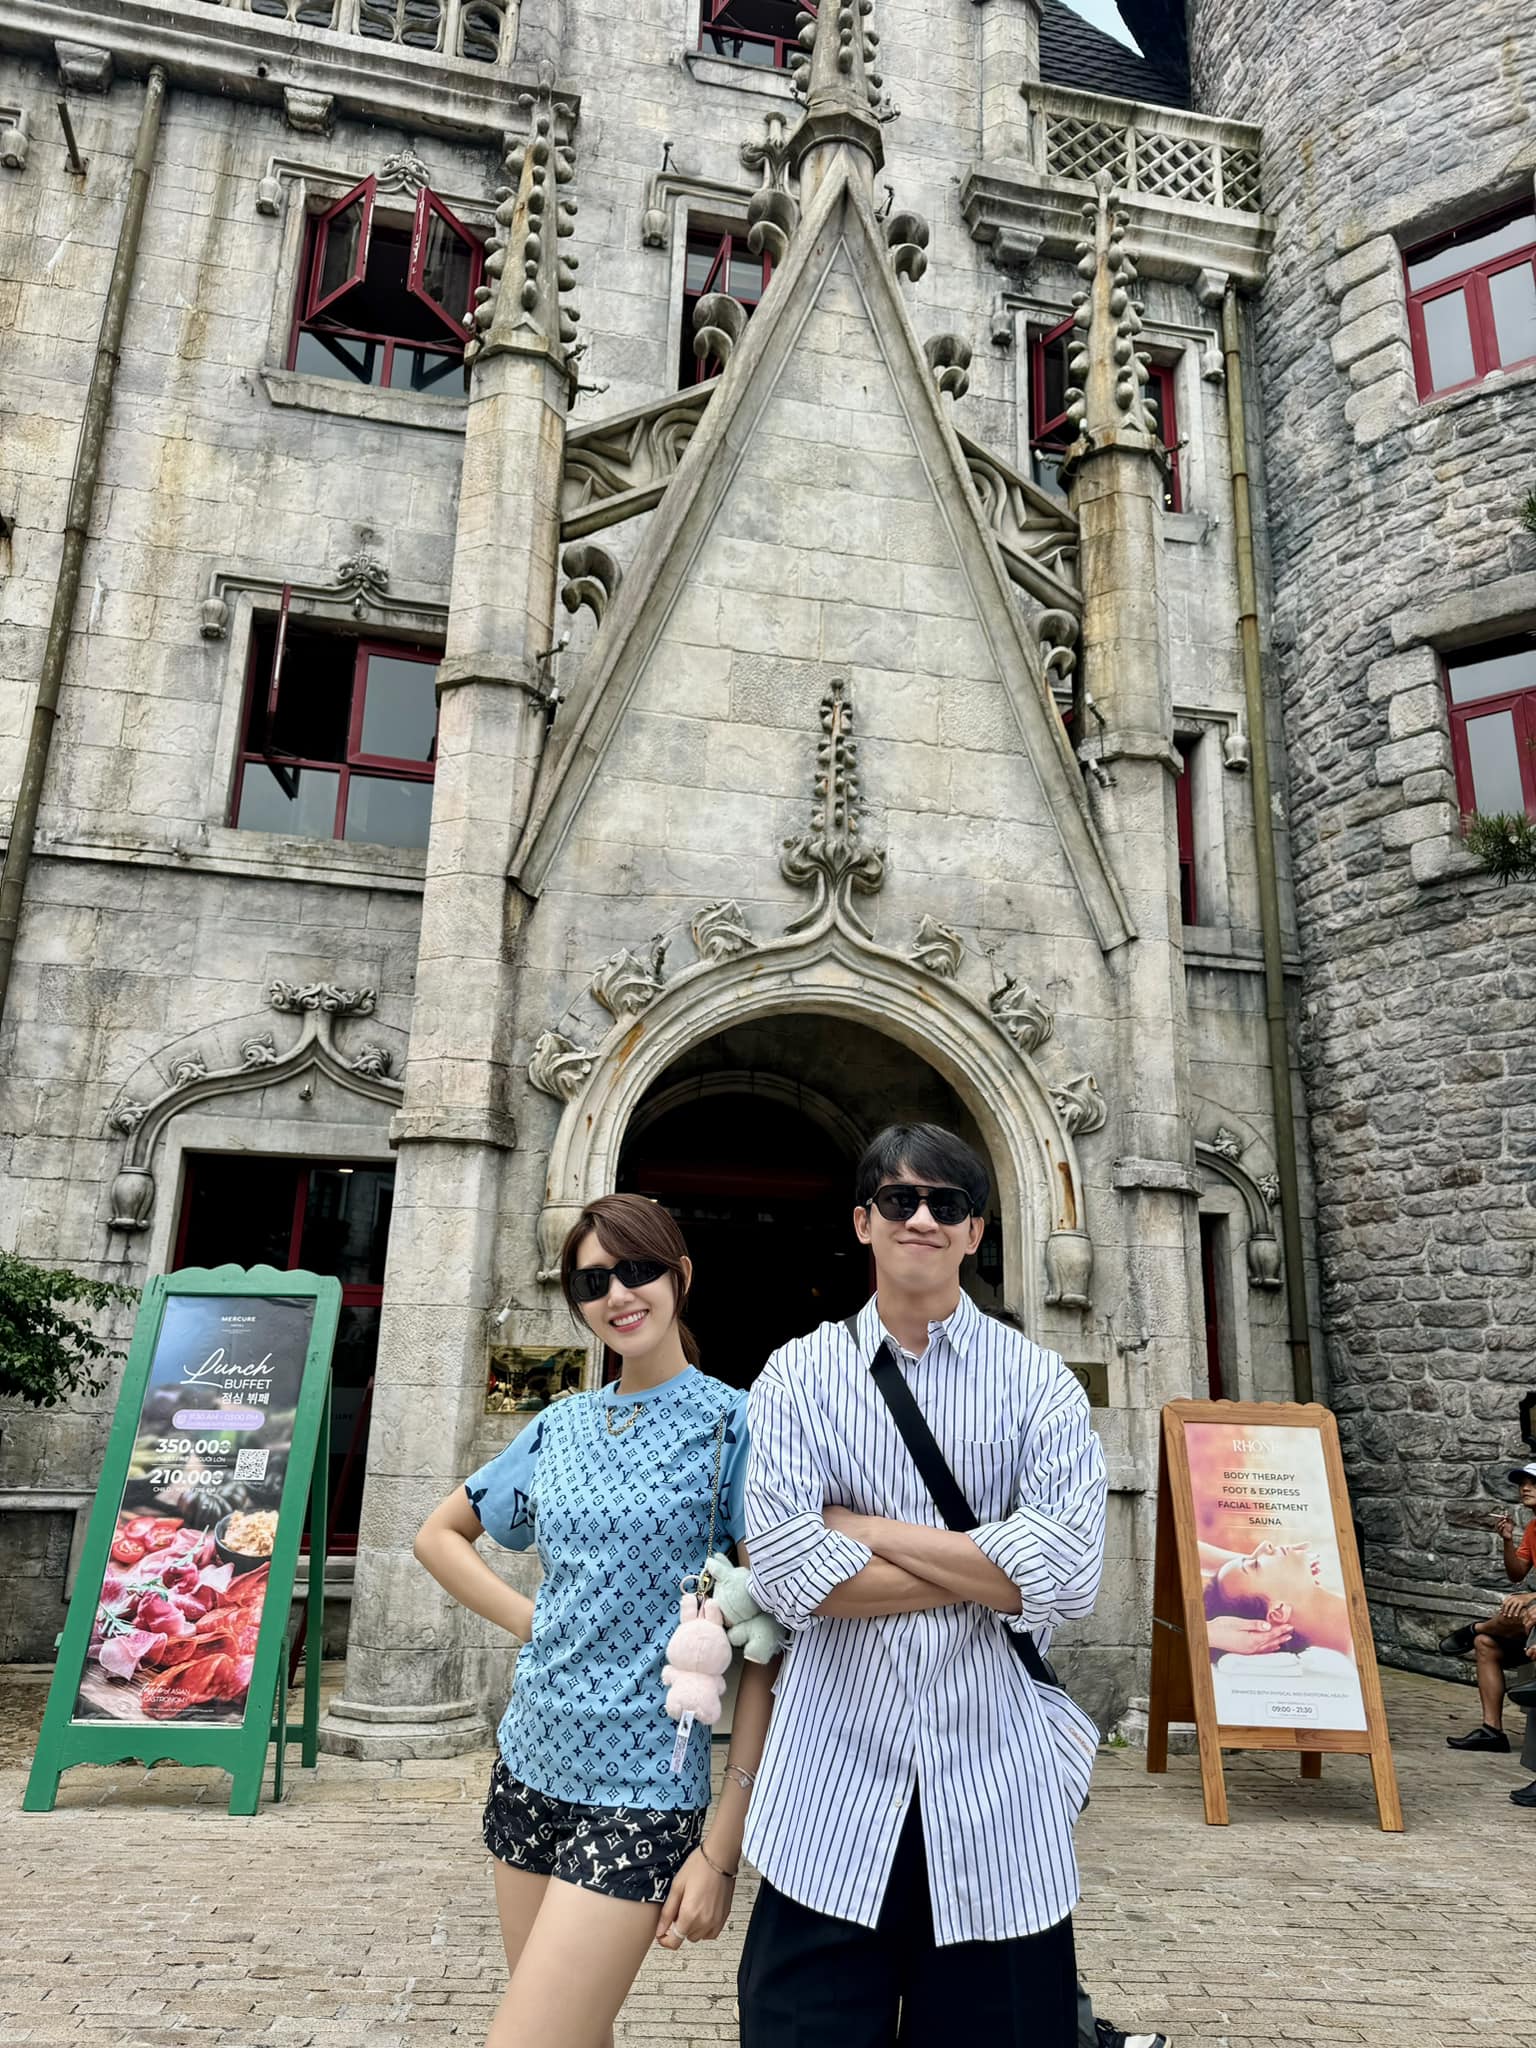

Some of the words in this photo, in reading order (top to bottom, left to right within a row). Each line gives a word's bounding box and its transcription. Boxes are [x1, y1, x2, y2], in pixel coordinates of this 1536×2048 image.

[180, 1348, 275, 1390] Lunch
[224, 1379, 272, 1390] BUFFET
[222, 1392, 243, 1405] 점심
[1223, 1471, 1250, 1480] BODY
[1252, 1472, 1295, 1481] THERAPY
[1222, 1486, 1248, 1495] FOOT
[1250, 1487, 1257, 1495] &
[1259, 1487, 1301, 1497] EXPRESS
[1218, 1500, 1251, 1509] FACIAL
[1252, 1502, 1309, 1511] TREATMENT
[1248, 1517, 1282, 1526] SAUNA
[1271, 1705, 1291, 1713] 09:00
